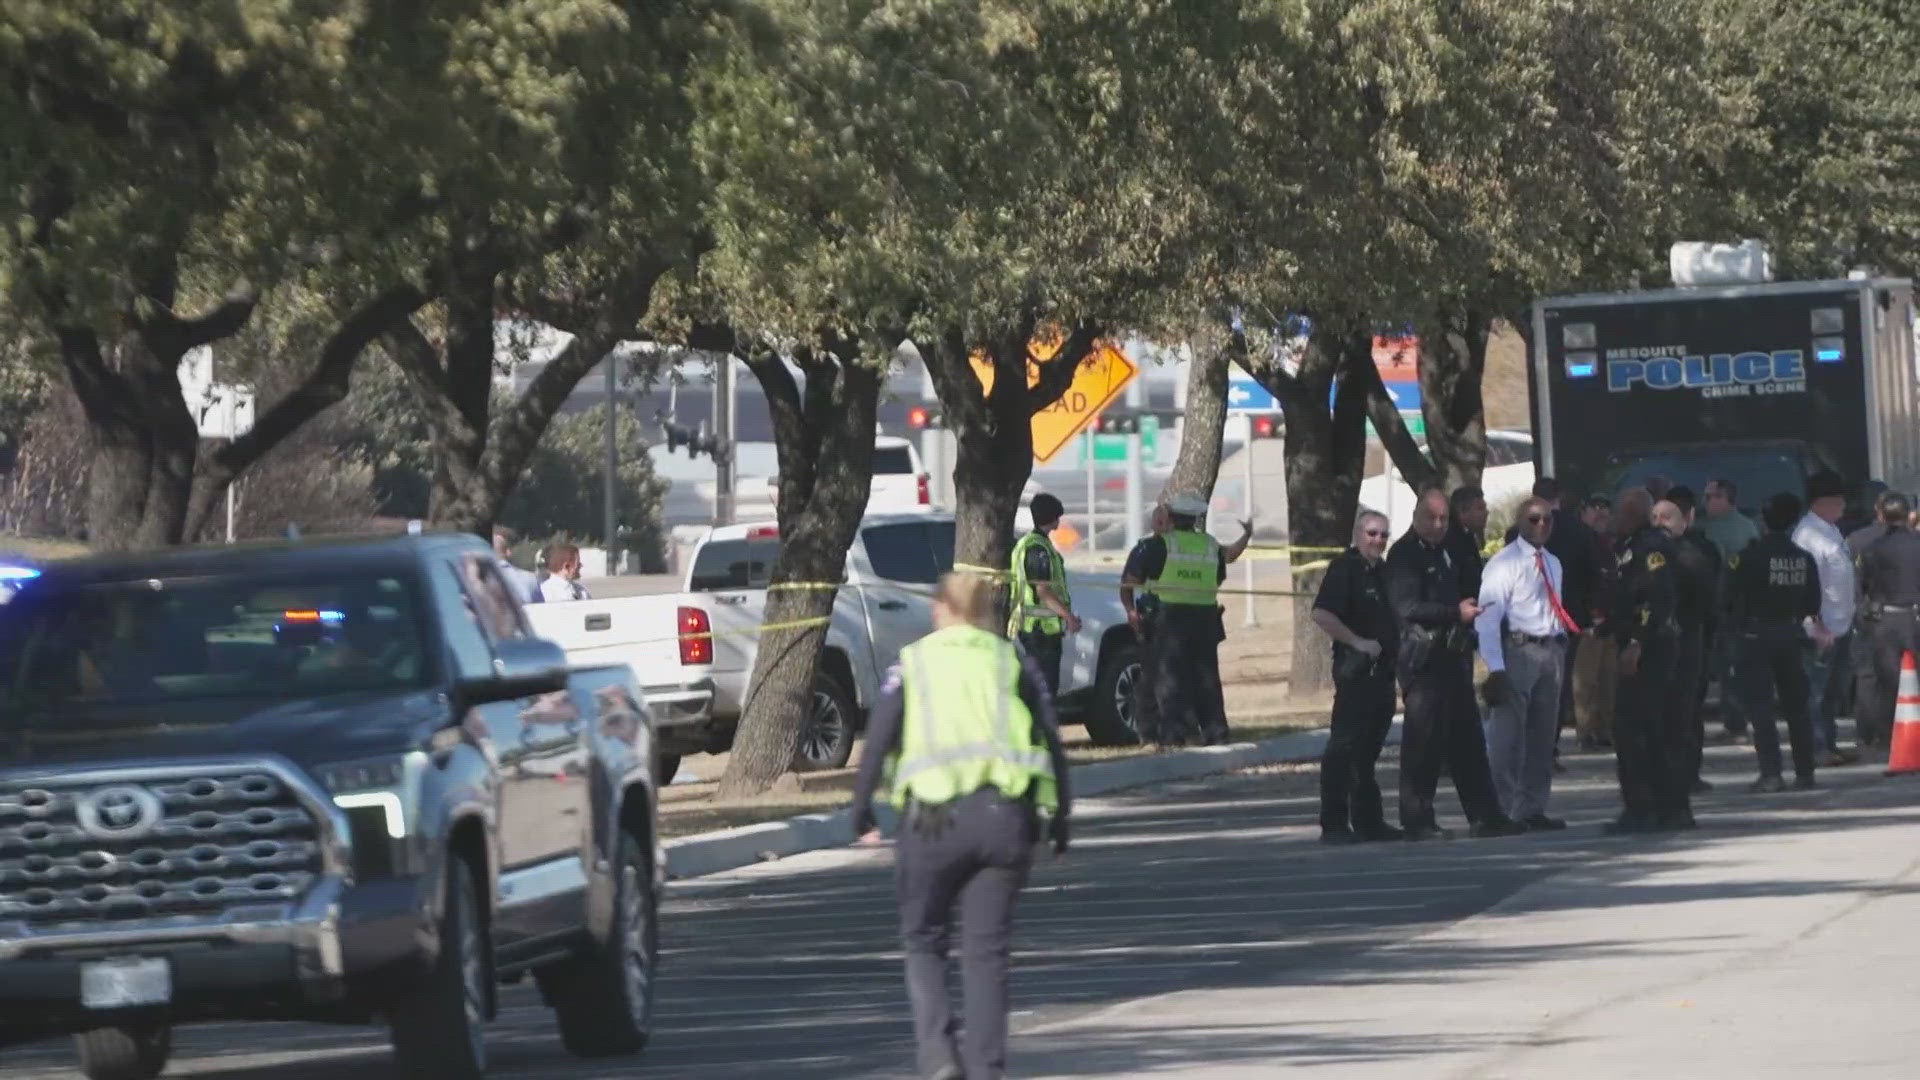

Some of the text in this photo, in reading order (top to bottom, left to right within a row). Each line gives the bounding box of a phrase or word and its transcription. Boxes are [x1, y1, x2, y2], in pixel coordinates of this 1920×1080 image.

[1606, 345, 1687, 359] MESQUITE
[1607, 350, 1806, 392] POLICE
[1702, 382, 1806, 398] CRIME SCENE
[1040, 392, 1087, 413] AD
[1177, 569, 1202, 580] POLICE
[1769, 571, 1805, 585] POLICE
